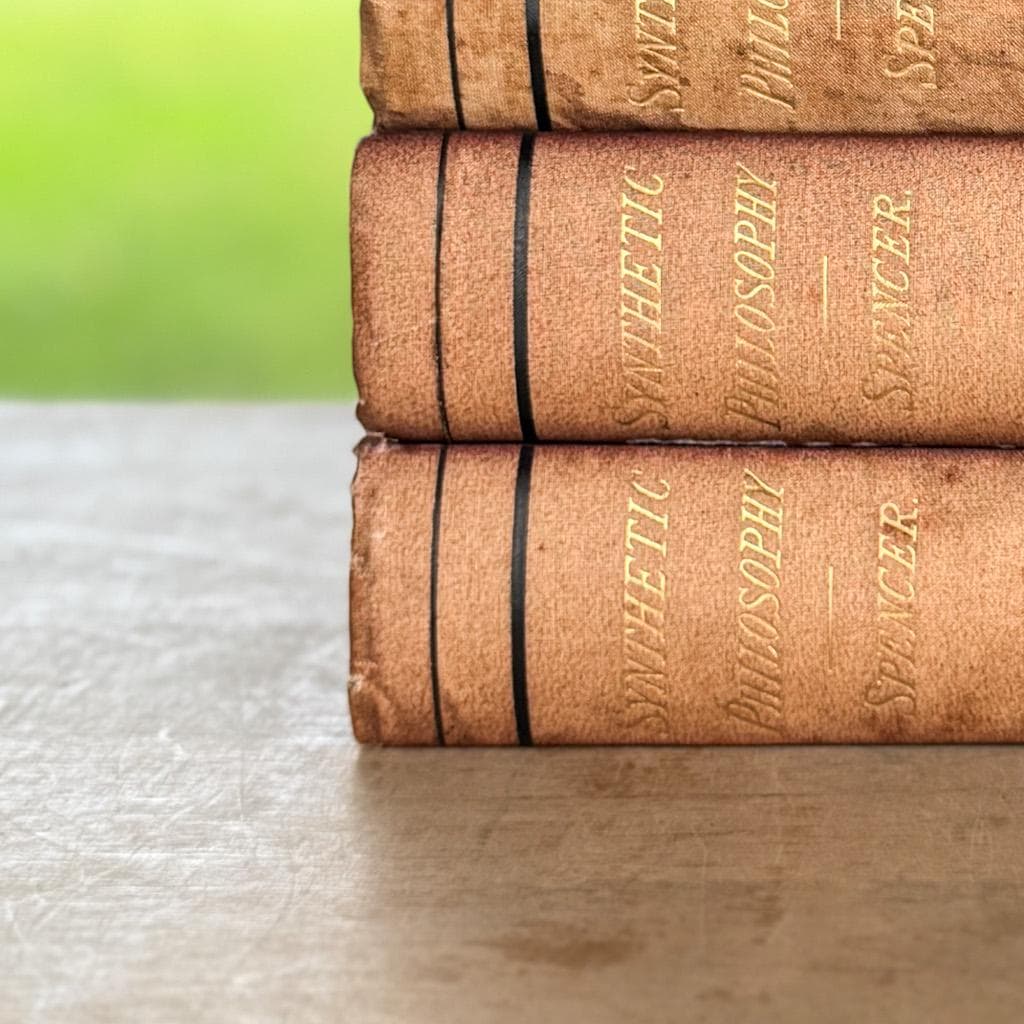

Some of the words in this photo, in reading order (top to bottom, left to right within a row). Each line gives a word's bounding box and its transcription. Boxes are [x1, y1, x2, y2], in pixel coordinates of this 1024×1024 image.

[613, 164, 669, 430] SYNTHETIC
[723, 161, 781, 432] PHILOSOPHY
[615, 468, 671, 737] SYNTHETIC
[724, 467, 784, 734] PHILOSOPHY
